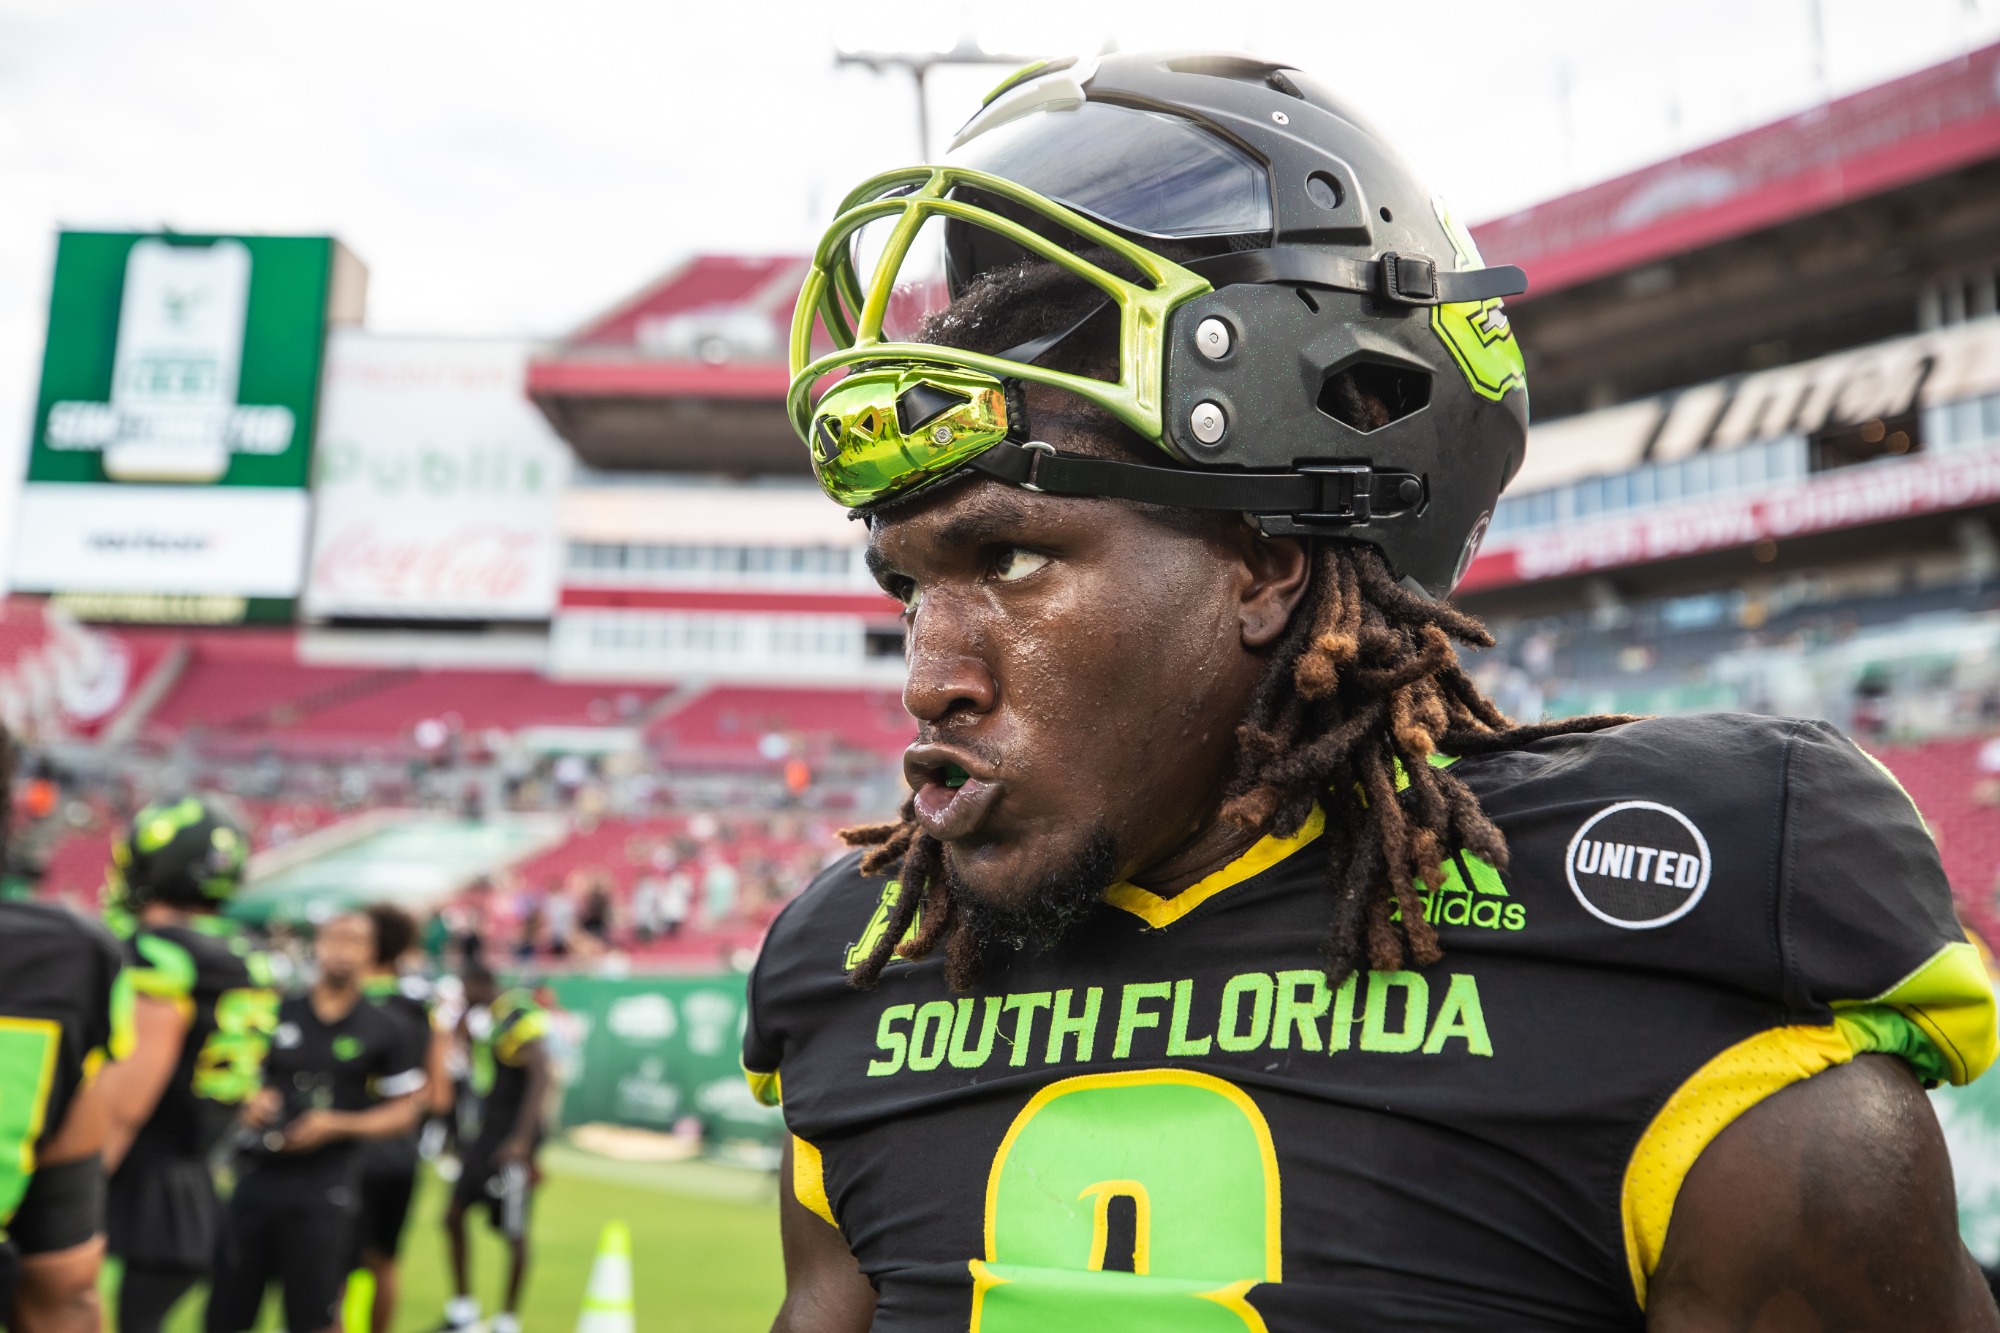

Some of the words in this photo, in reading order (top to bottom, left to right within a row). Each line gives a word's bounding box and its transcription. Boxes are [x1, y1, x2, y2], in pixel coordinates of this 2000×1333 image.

[1577, 839, 1700, 889] UNITED
[867, 987, 1104, 1077] SOUTH
[1111, 969, 1494, 1058] FLORIDA
